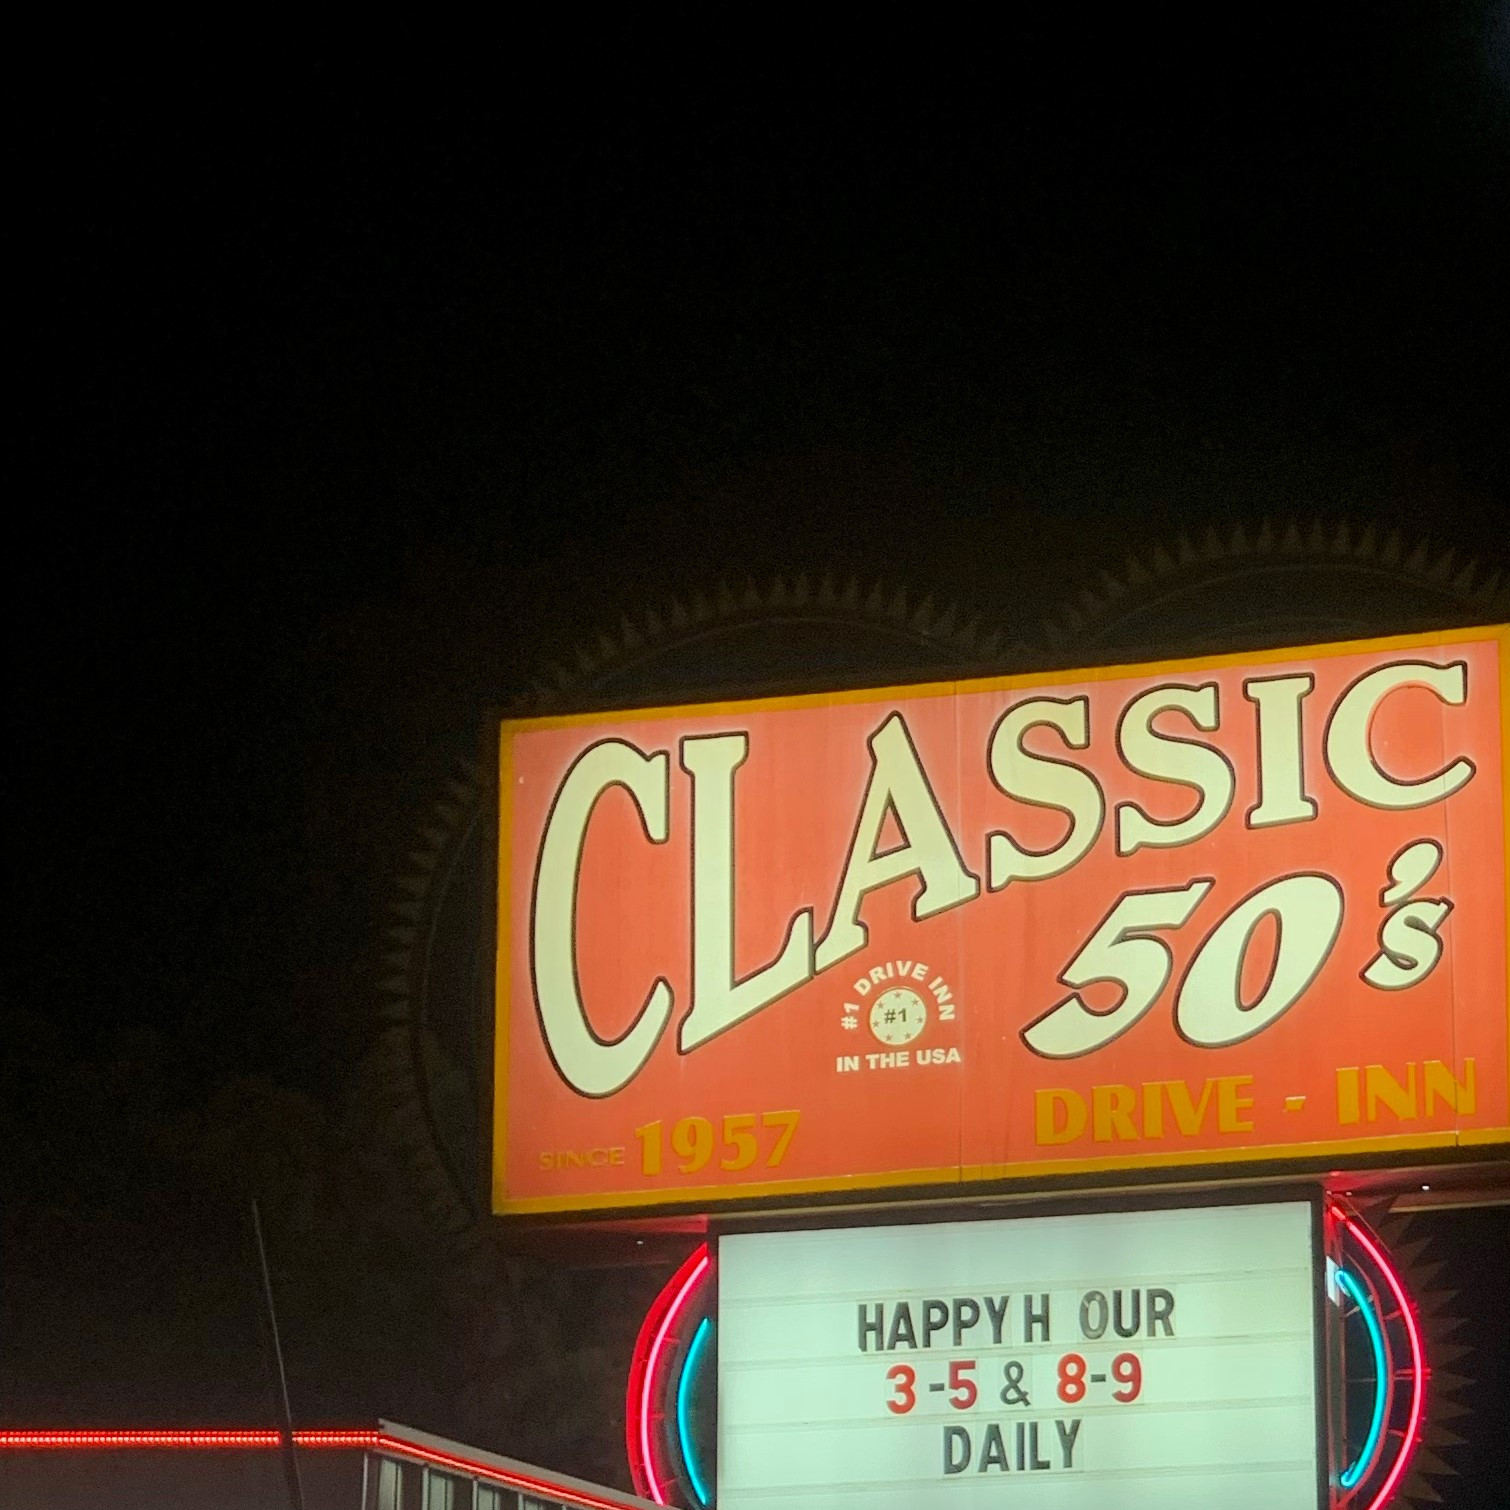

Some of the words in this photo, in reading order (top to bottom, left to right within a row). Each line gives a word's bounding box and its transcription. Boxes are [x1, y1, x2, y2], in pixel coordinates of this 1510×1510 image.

[529, 660, 1475, 1098] CLASSIC
[840, 1002, 859, 1030] #1
[853, 960, 929, 996] DRIVE
[928, 976, 955, 1021] INN
[884, 1008, 907, 1024] #1
[836, 1056, 859, 1072] IN
[865, 1051, 910, 1069] THE
[916, 1047, 961, 1065] USA
[1033, 1075, 1254, 1147] DRIVE
[1335, 1058, 1475, 1126] INN
[538, 1146, 625, 1172] SINCE
[635, 1109, 801, 1177] 1957
[858, 1295, 1009, 1352] HAPPY
[1001, 1360, 1031, 1406] &
[1057, 1352, 1142, 1403] 8-9
[943, 1418, 1082, 1475] DAILY
